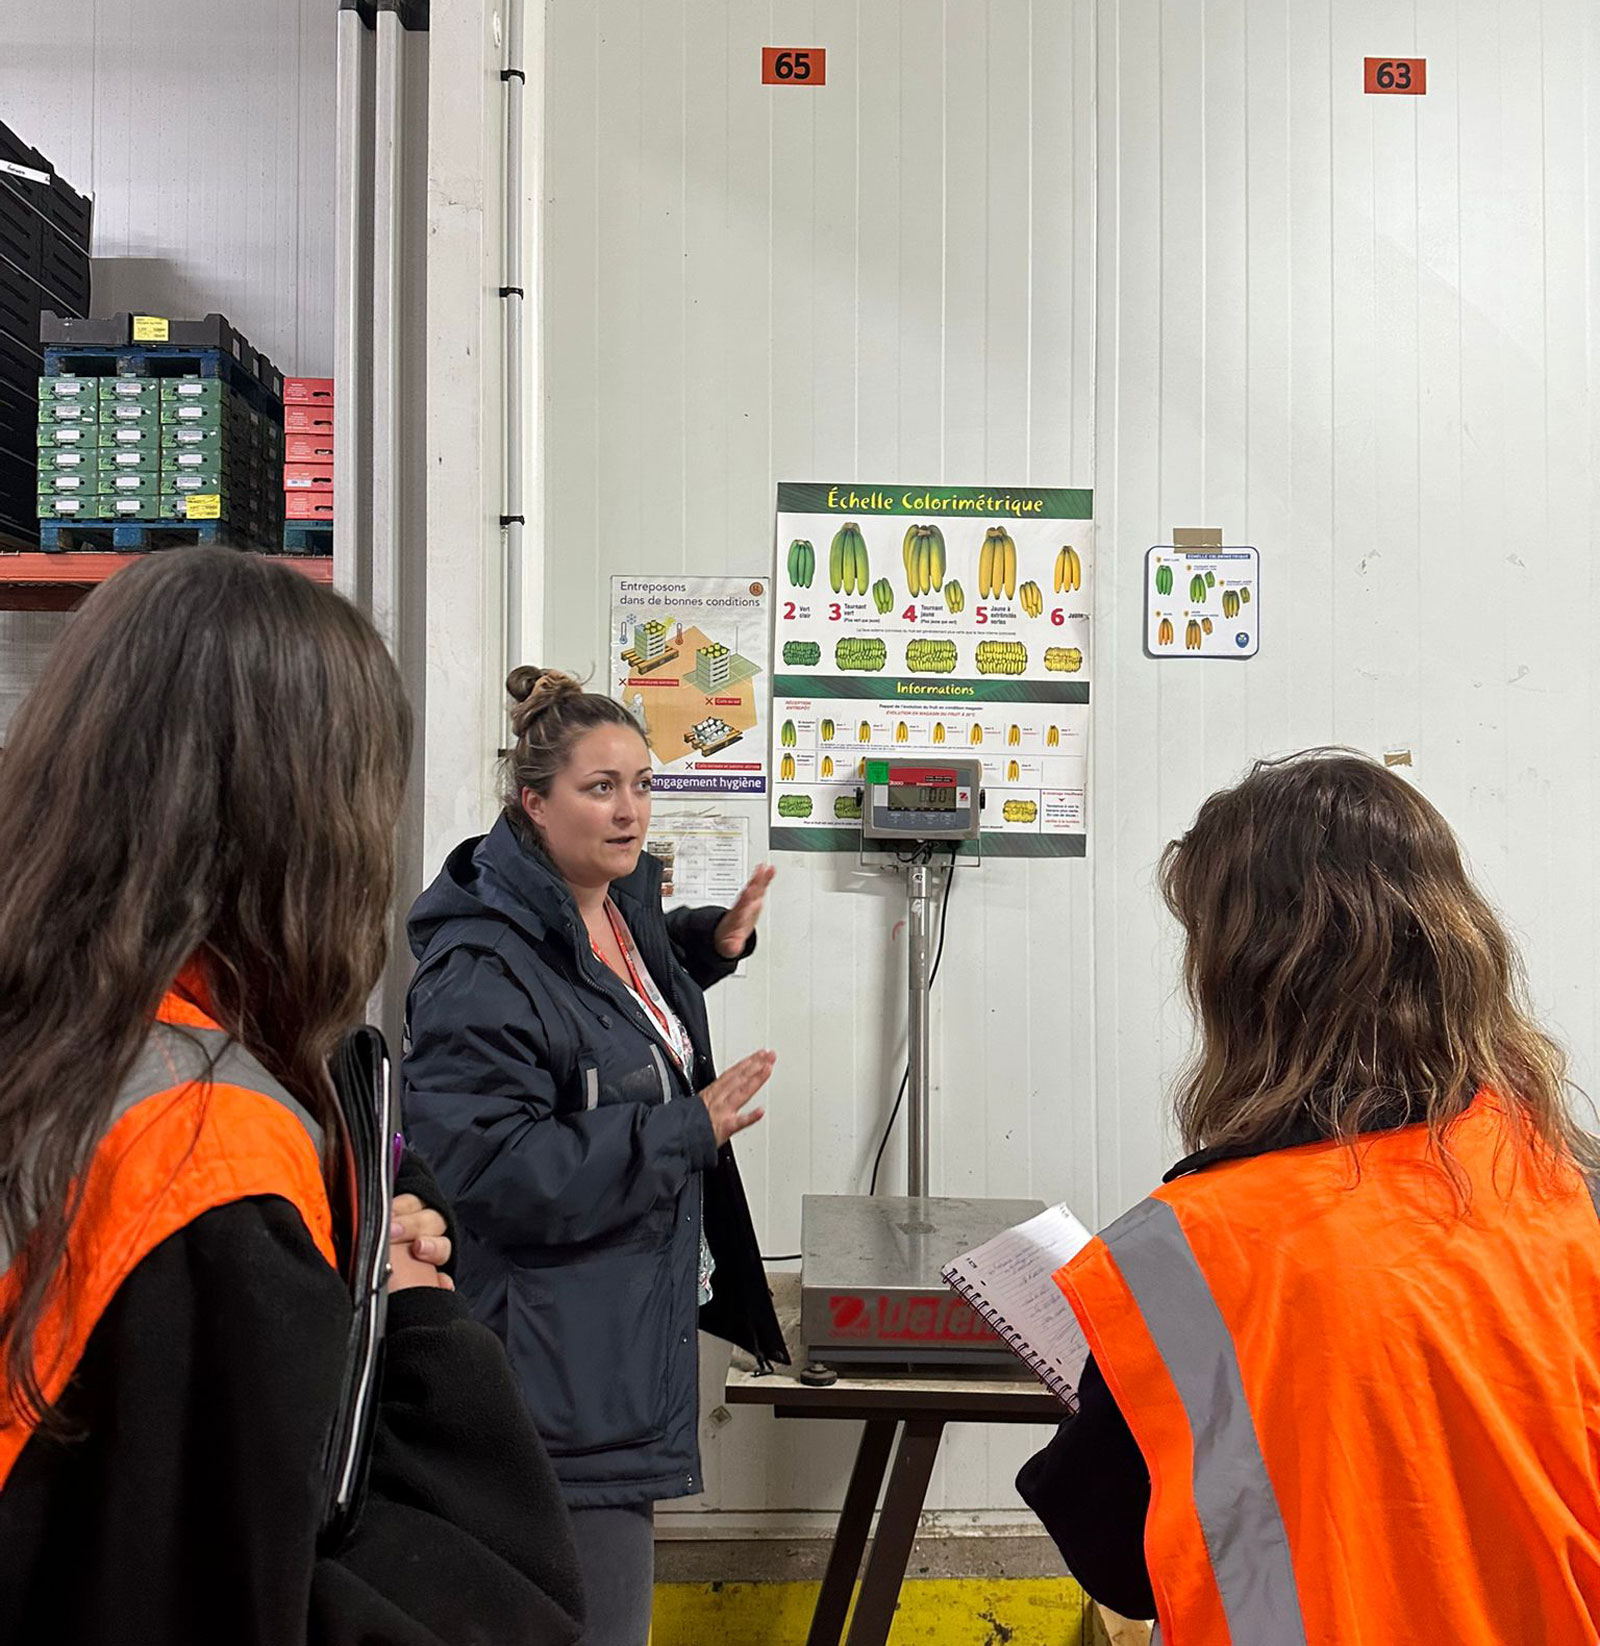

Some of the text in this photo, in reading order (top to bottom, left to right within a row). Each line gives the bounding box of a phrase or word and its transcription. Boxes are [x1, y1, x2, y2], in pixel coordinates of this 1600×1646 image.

[775, 52, 811, 79] 65
[1376, 62, 1411, 89] 63
[827, 486, 1044, 517] Échelle Colorimétrique
[620, 580, 686, 594] Entreposons
[619, 595, 760, 607] dans de bonnes conditions
[783, 601, 796, 620] 2
[828, 603, 842, 621] 3
[902, 604, 918, 623] 4
[975, 606, 989, 624] 5
[1050, 607, 1065, 626] 6
[896, 680, 975, 696] Informations
[651, 775, 762, 790] engagement hygiène
